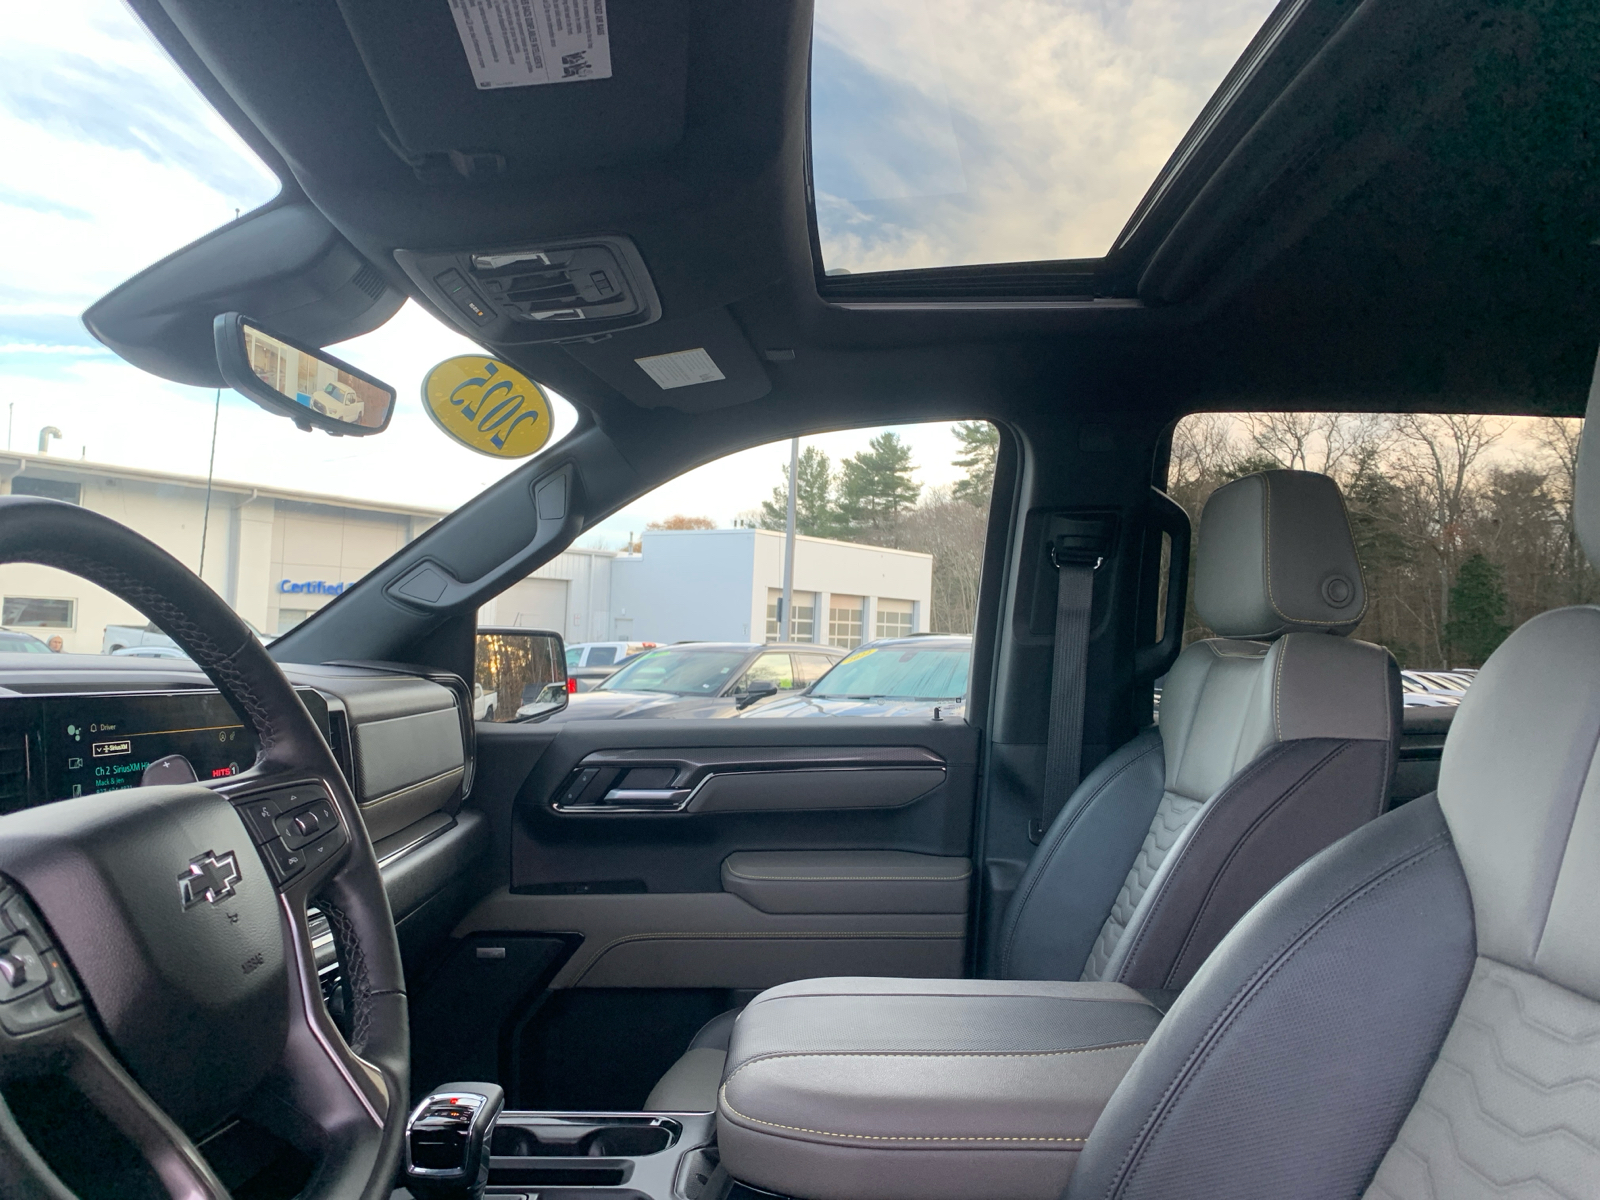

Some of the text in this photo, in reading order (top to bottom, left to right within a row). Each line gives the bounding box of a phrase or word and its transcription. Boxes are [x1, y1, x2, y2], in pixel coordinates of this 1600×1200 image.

[280, 579, 344, 595] Certified
[101, 723, 116, 731] Driver
[96, 767, 105, 776] Ch
[105, 766, 111, 775] 2
[113, 762, 141, 775] SiriusXM
[213, 767, 231, 777] HITS
